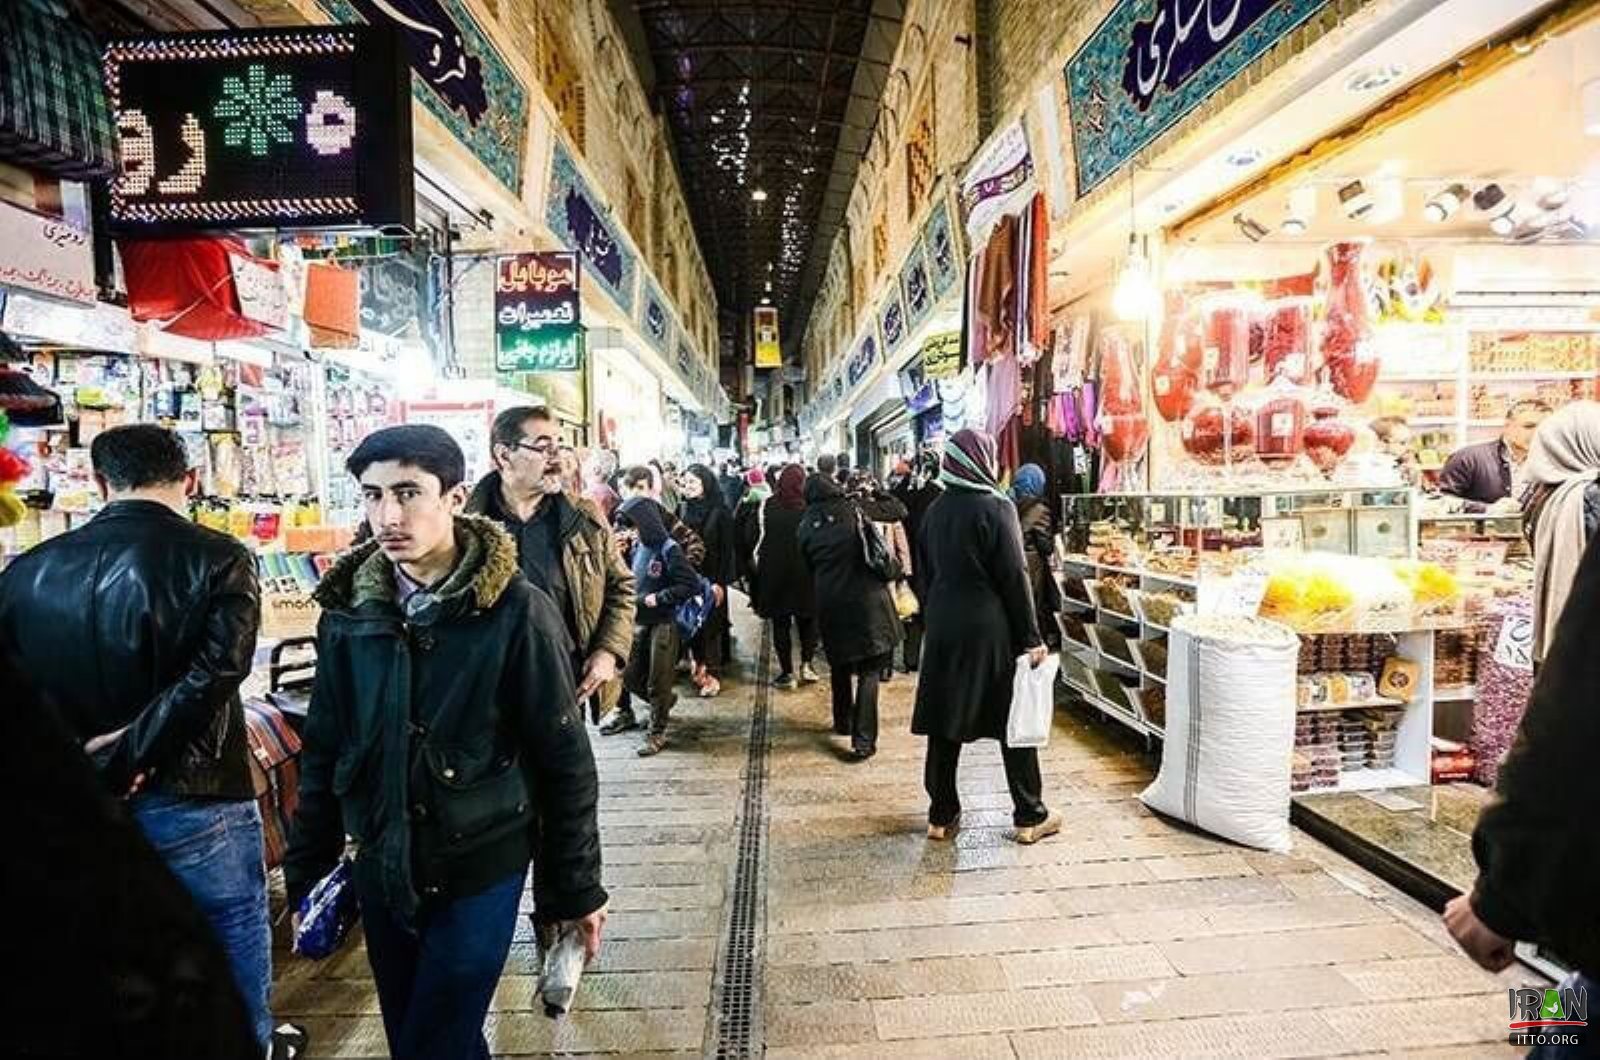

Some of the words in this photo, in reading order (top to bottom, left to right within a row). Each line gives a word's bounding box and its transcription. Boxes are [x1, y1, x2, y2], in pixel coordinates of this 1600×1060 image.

[43, 225, 84, 248] رومیزی
[500, 259, 574, 292] موبایل
[499, 301, 574, 331] تعمیرات
